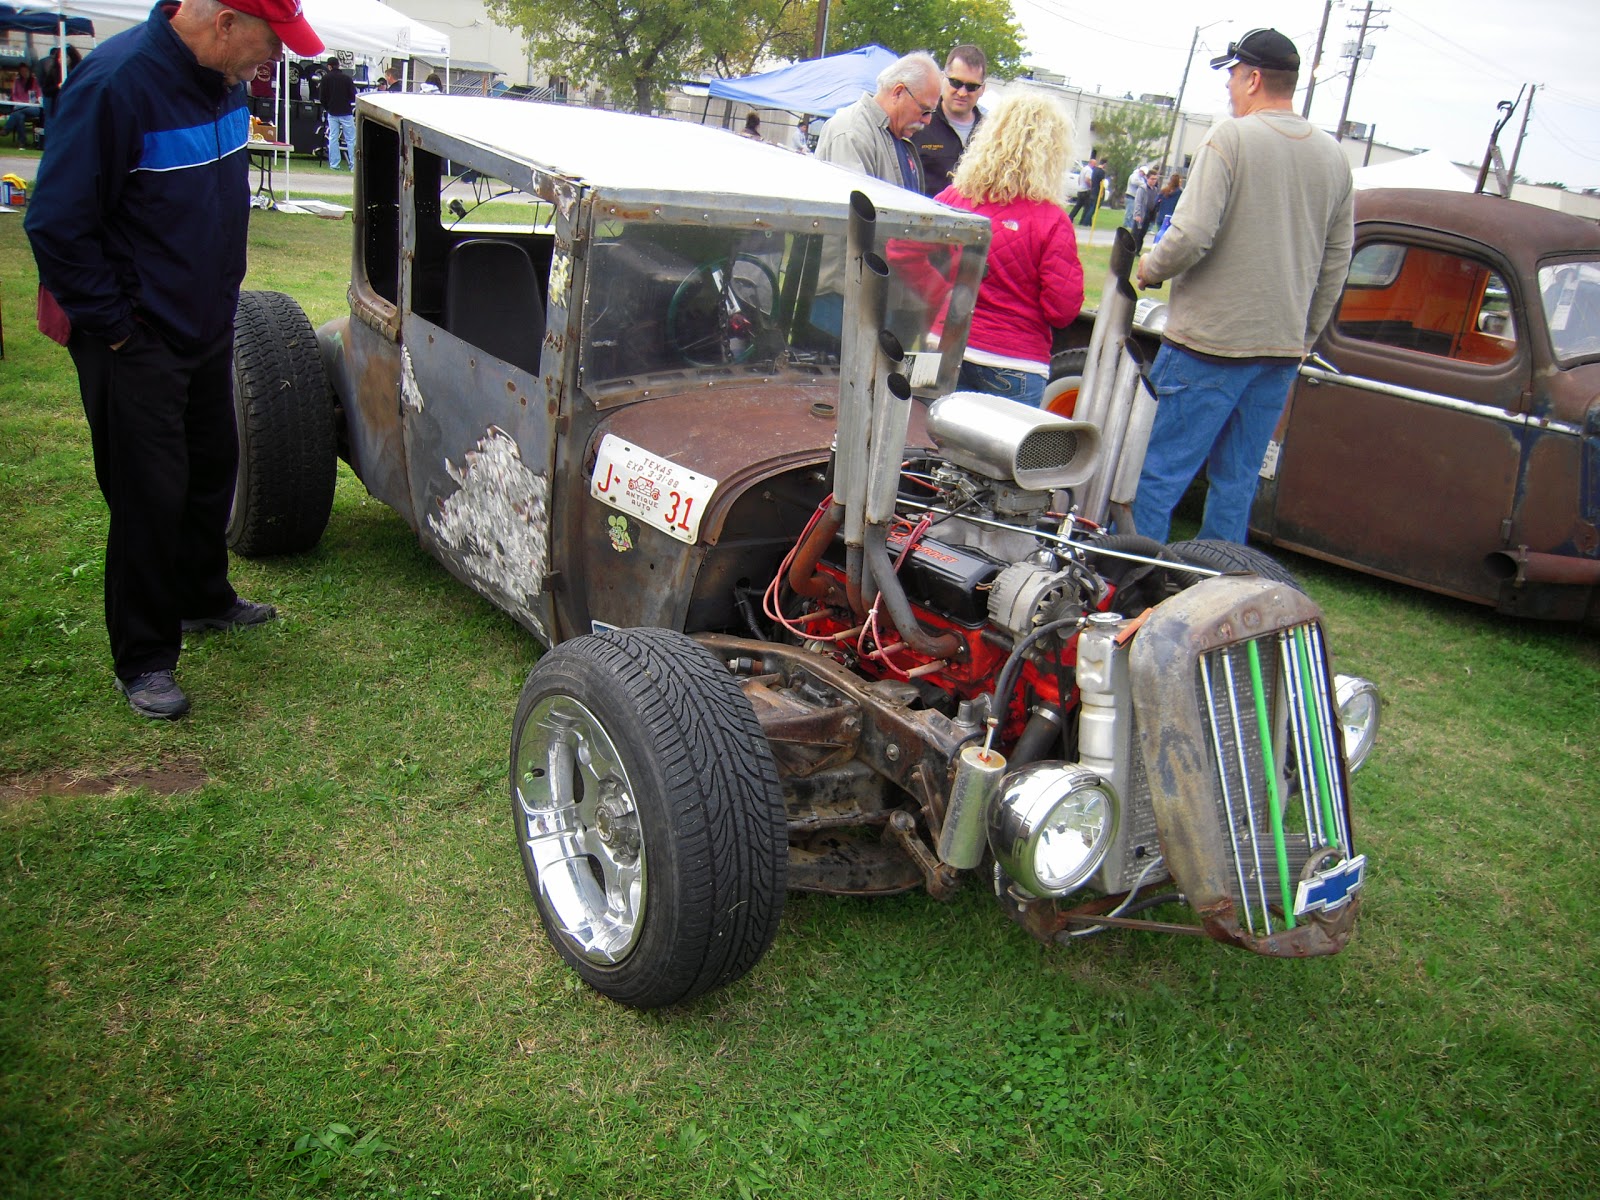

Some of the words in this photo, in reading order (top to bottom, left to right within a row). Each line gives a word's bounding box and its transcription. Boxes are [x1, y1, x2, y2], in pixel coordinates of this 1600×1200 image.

[643, 457, 673, 476] TEXAS
[597, 463, 613, 493] J
[664, 490, 694, 531] 31
[626, 490, 659, 509] ANTIQUE
[631, 500, 651, 511] AUTO
